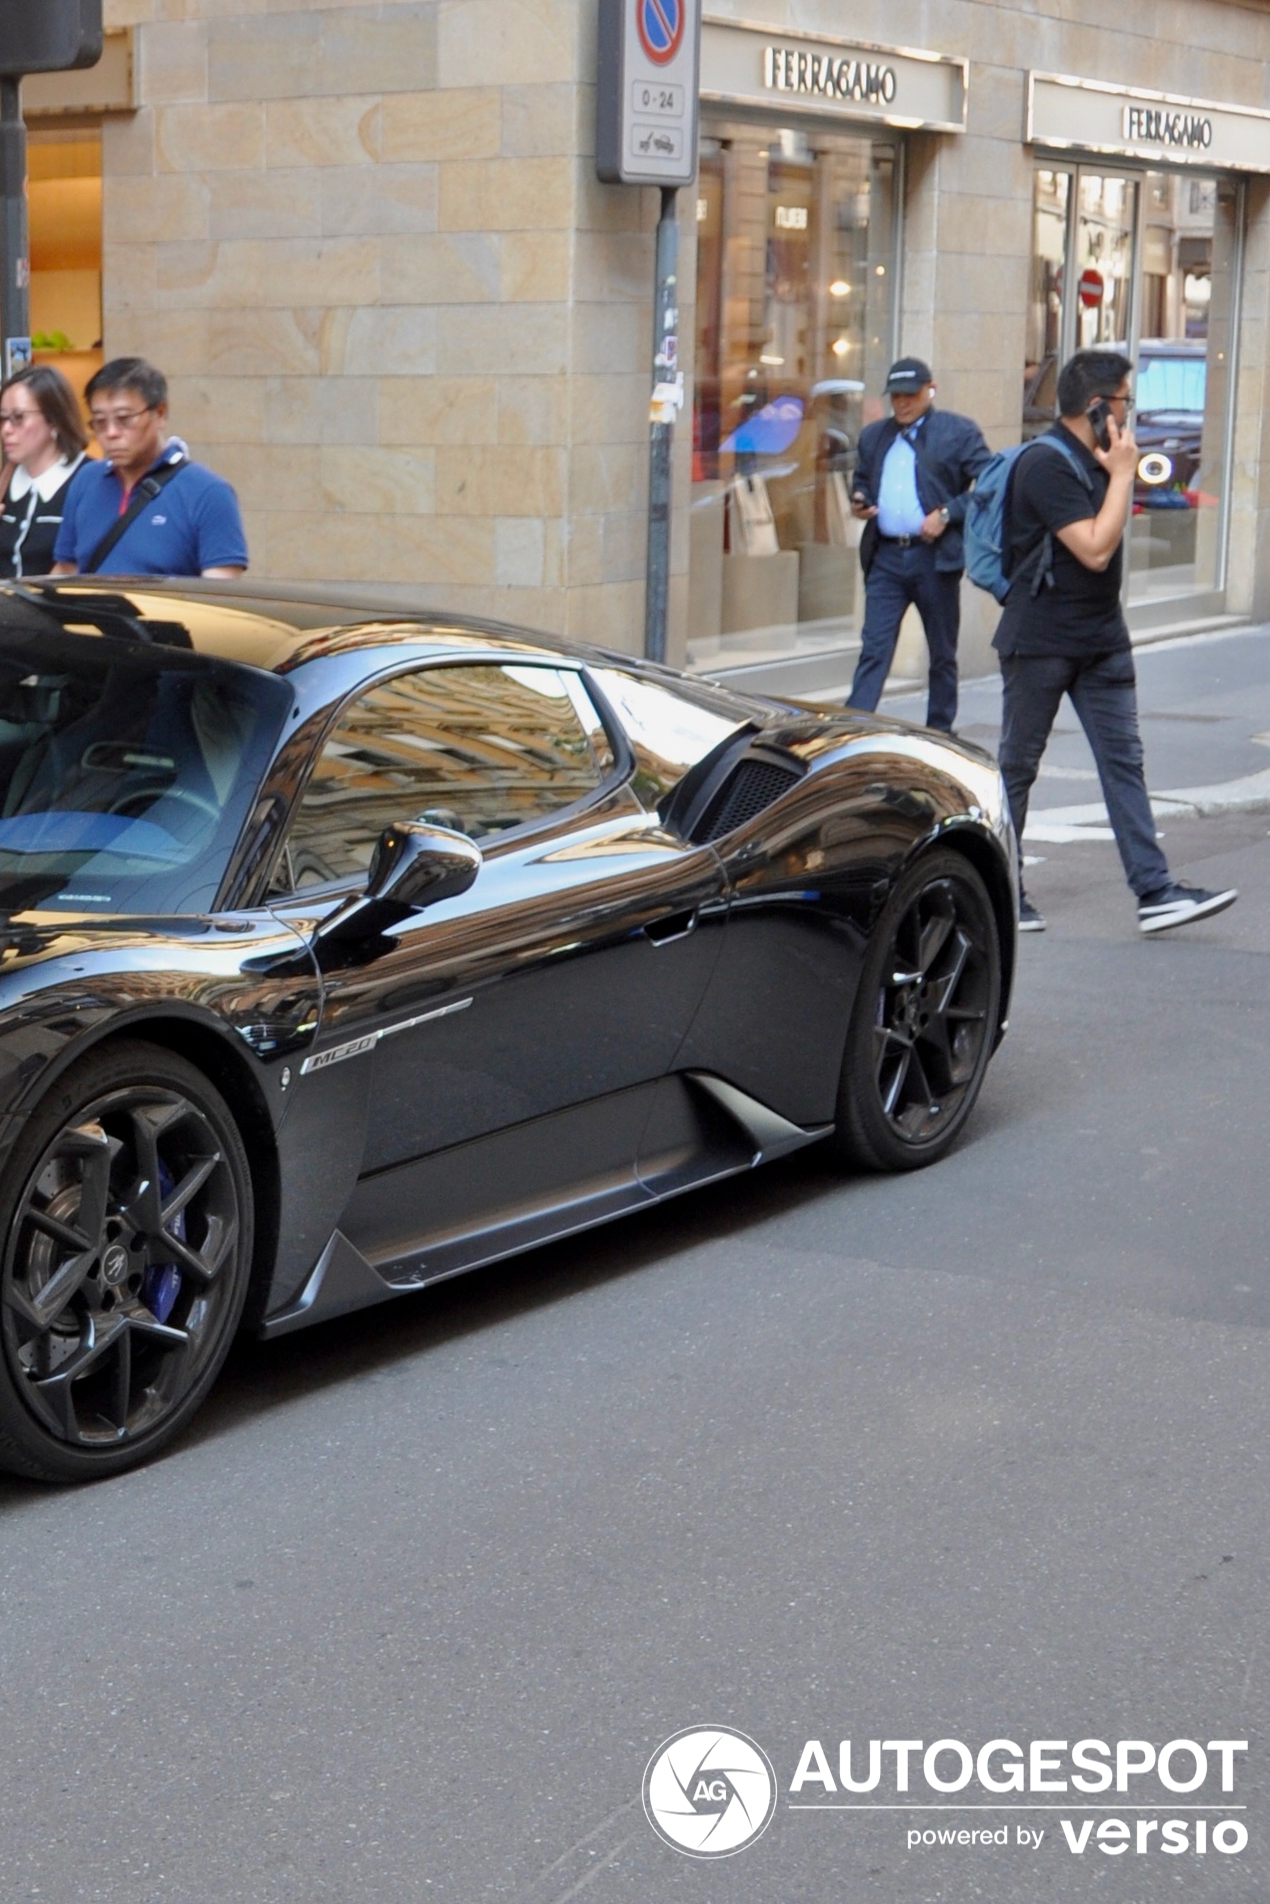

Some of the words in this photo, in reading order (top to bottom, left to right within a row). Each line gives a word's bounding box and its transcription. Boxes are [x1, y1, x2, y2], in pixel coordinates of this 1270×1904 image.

[765, 46, 896, 104] FERRAGAMO
[642, 88, 650, 107] 0
[659, 91, 674, 108] 24
[1123, 105, 1212, 149] FERRAGAMO
[312, 1038, 371, 1067] MC20
